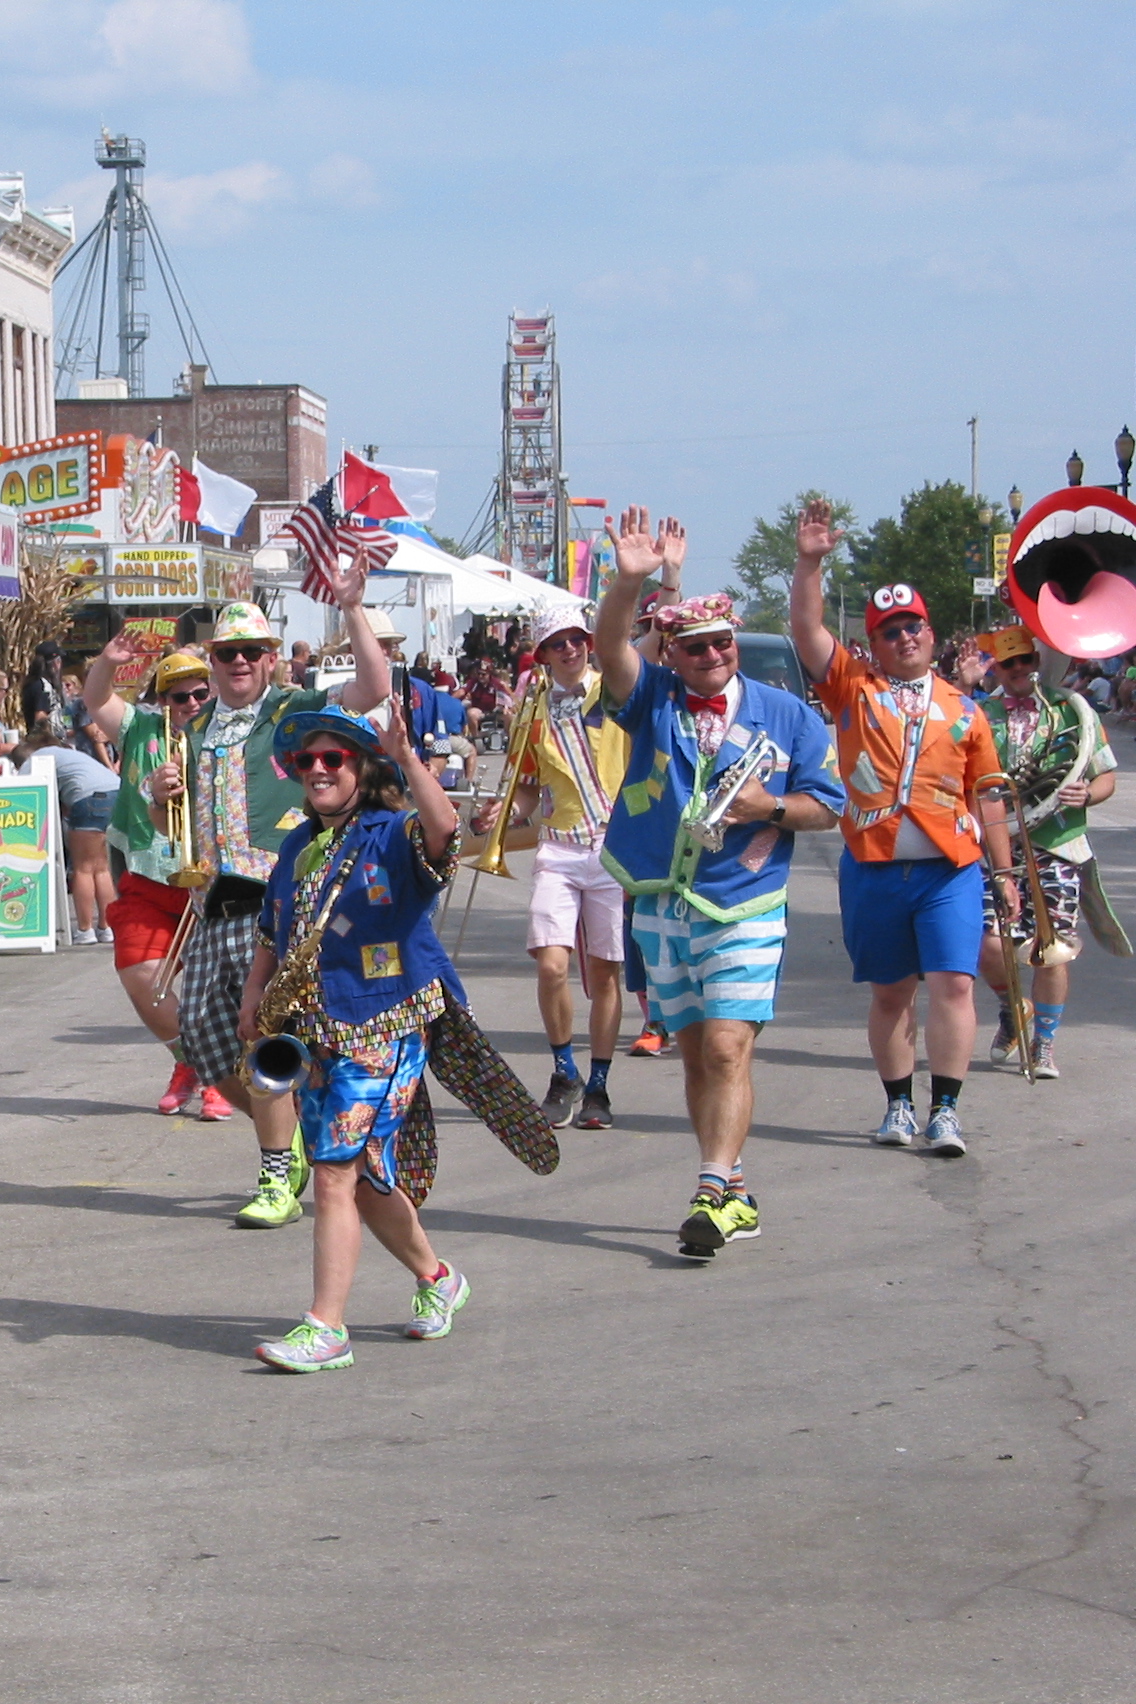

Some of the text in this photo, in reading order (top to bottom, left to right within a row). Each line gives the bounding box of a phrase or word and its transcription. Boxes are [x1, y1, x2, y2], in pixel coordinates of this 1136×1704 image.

[123, 550, 188, 562] HAND DIPPED
[114, 562, 155, 597] CORN
[158, 562, 198, 597] DOGS
